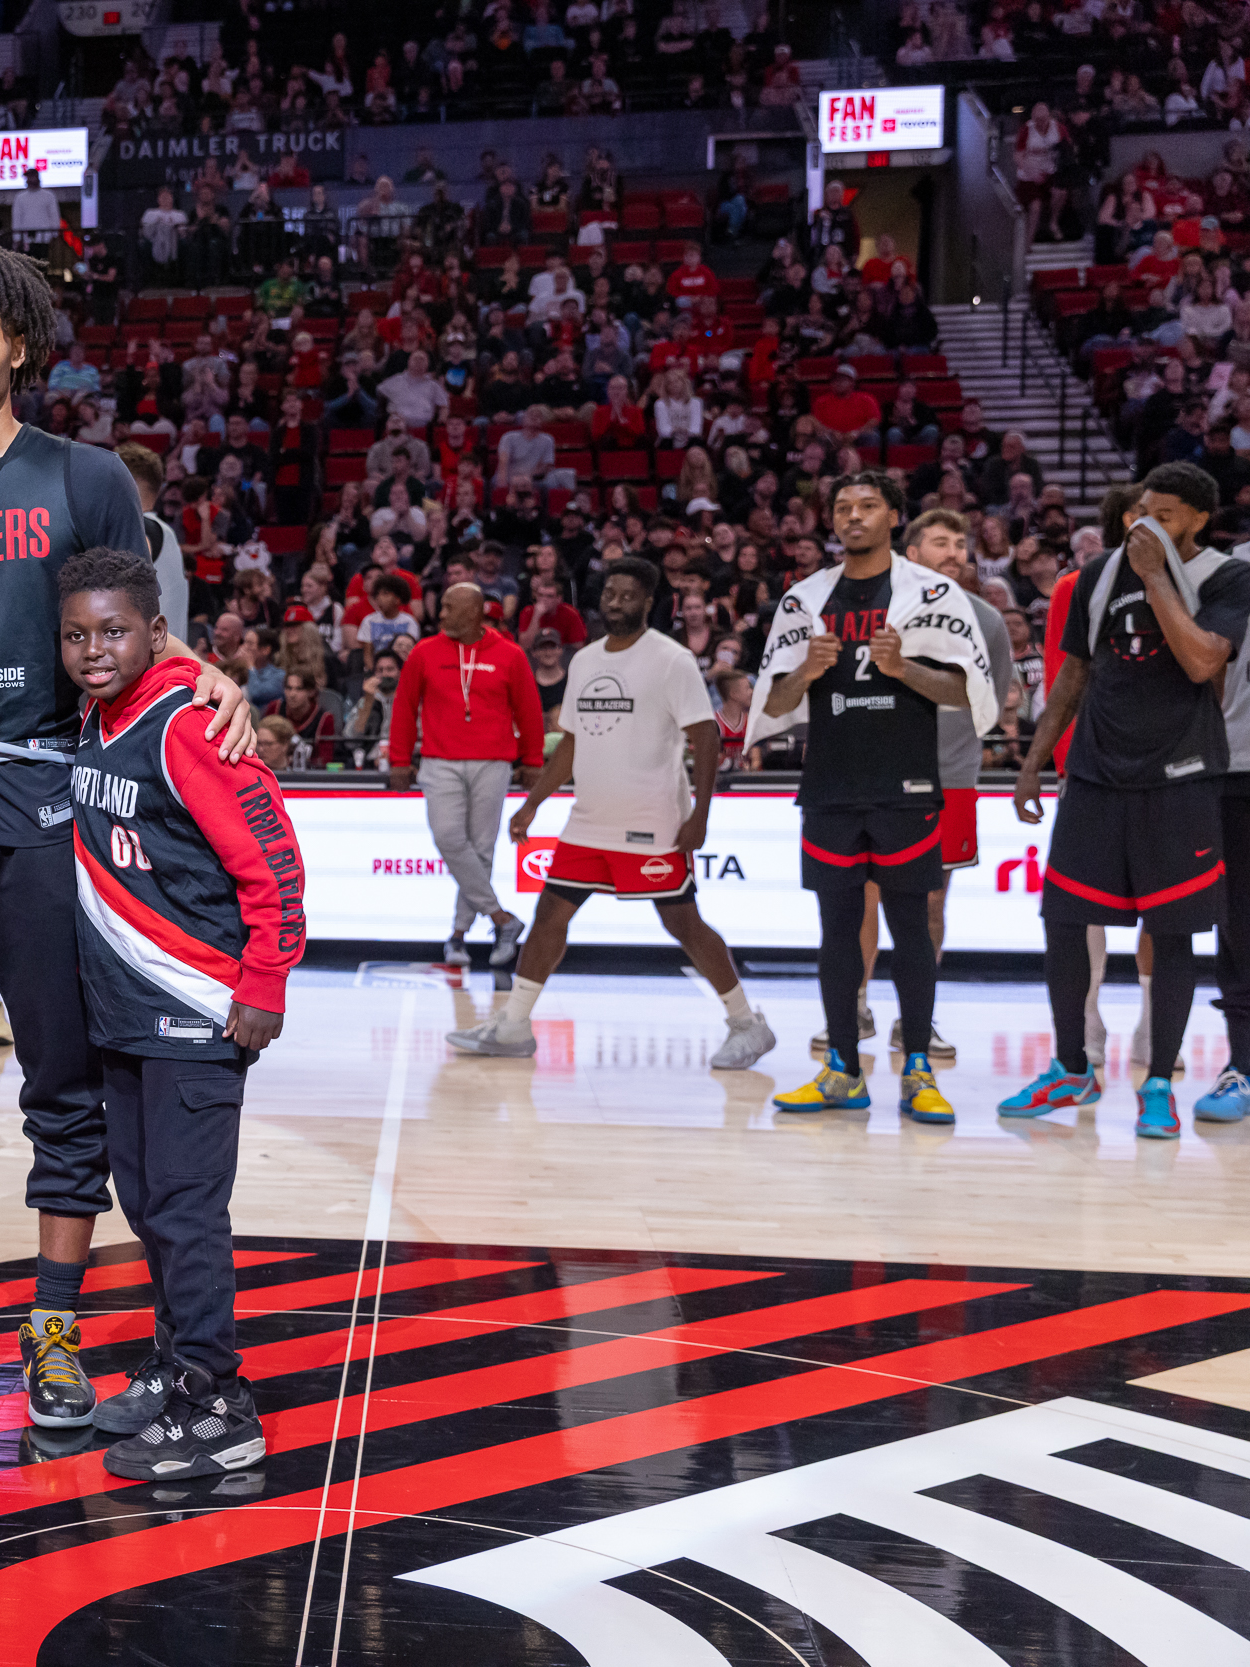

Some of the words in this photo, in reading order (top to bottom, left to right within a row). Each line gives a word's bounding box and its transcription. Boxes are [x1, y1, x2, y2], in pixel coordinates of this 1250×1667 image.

[829, 96, 875, 122] FAN
[119, 134, 240, 160] DAIMLER
[255, 130, 342, 154] TRUCK
[829, 124, 874, 142] FEST
[855, 645, 872, 681] 2
[594, 700, 631, 711] BLAZERS
[846, 696, 895, 707] BRIGHTSIDE
[236, 776, 287, 853] TRAIL
[265, 848, 305, 952] BLAZERS
